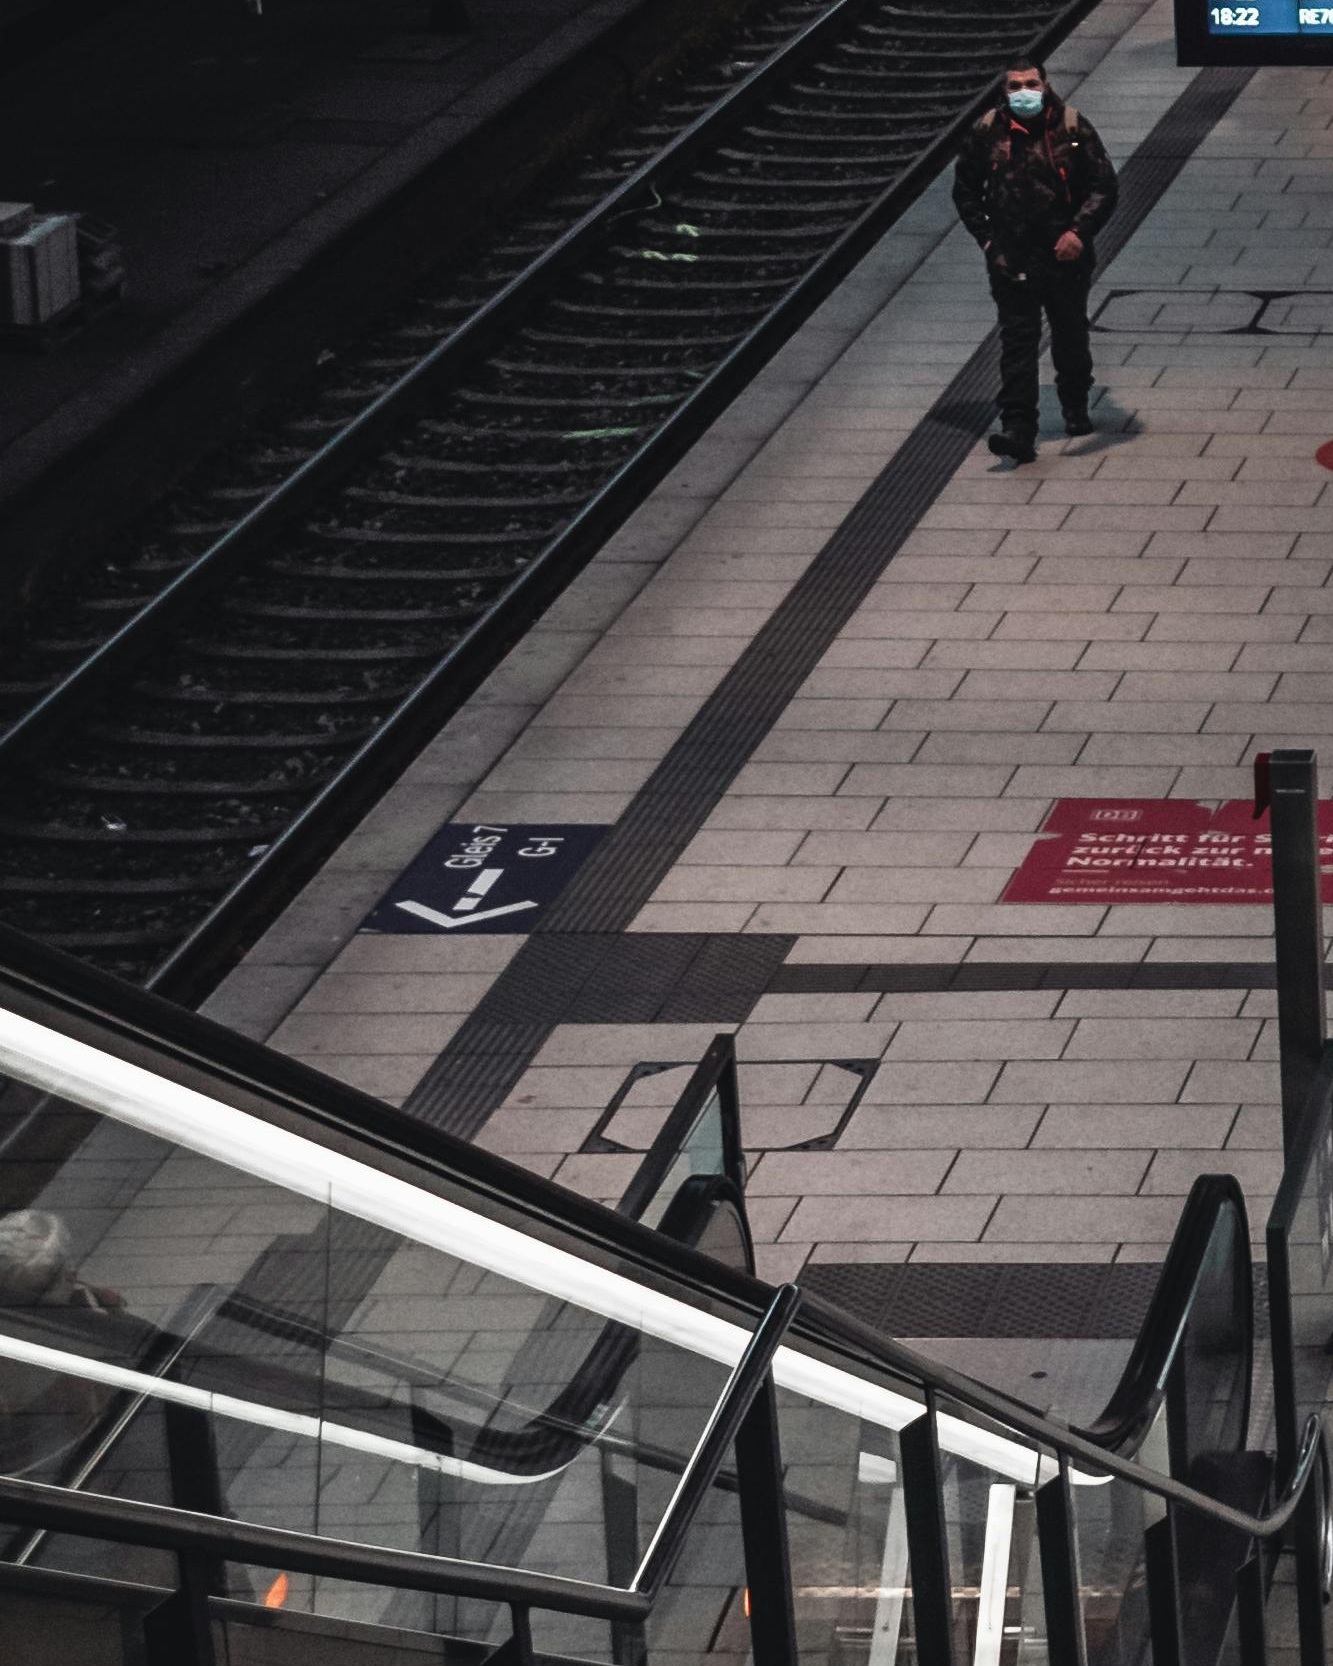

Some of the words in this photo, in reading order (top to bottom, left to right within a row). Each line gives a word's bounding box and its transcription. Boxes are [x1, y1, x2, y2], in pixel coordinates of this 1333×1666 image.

[1210, 7, 1260, 26] 18:22
[1094, 809, 1139, 821] DB
[472, 824, 509, 833] 7
[1077, 833, 1190, 844] Schritt
[1196, 833, 1246, 844] für
[443, 834, 503, 869] Gleis
[517, 836, 565, 858] G-I
[1071, 844, 1182, 856] zurück
[1190, 846, 1246, 856] zur
[1065, 856, 1255, 868] Normalität.
